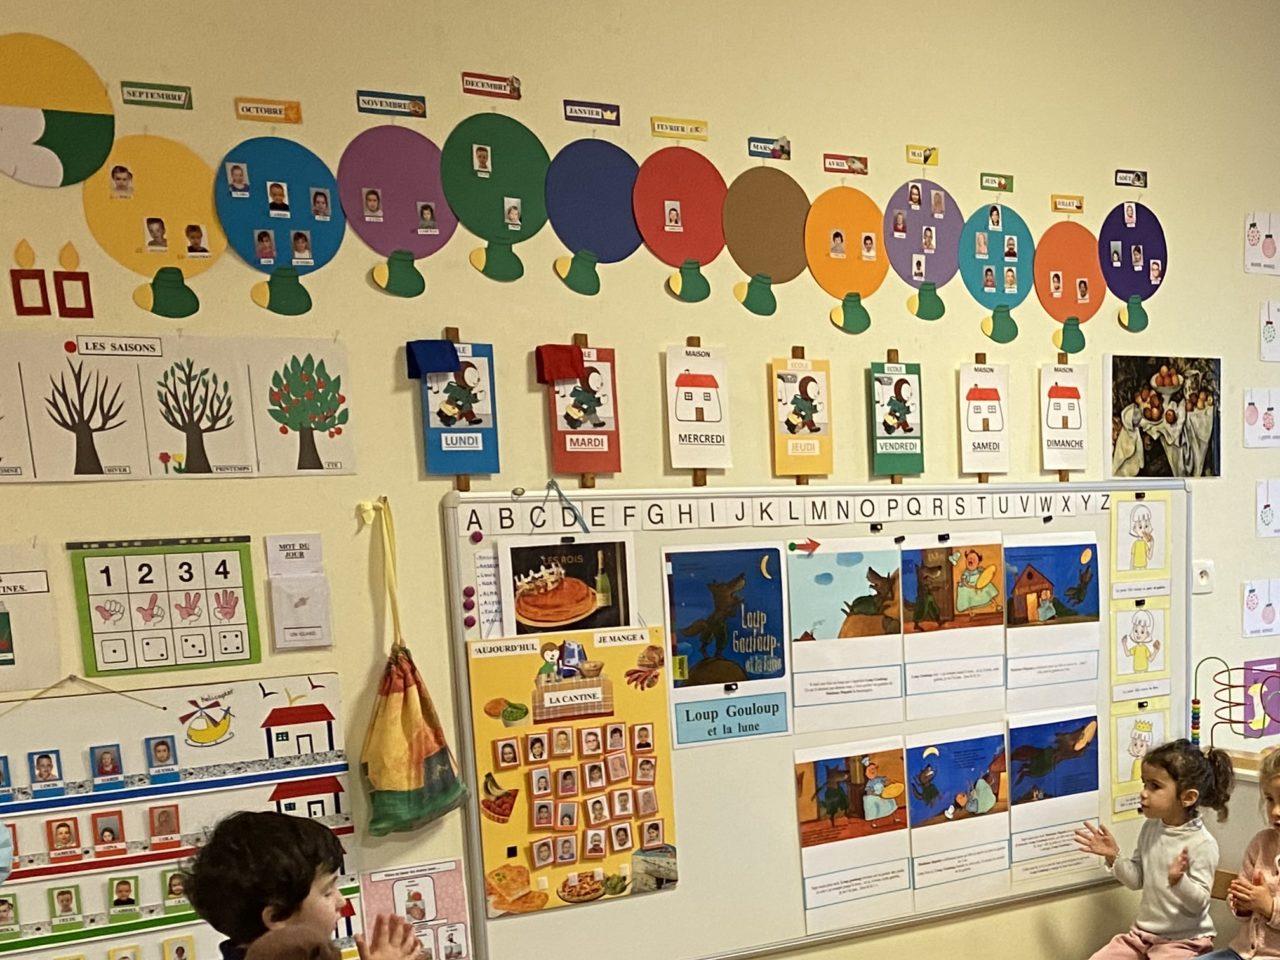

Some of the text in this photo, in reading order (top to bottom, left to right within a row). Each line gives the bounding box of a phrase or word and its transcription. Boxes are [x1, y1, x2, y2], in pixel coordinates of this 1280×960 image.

[465, 79, 508, 91] DECEMBRE
[126, 90, 183, 102] SEPTEMBRE
[361, 98, 408, 110] NOVEMBRE
[241, 106, 283, 116] OCTOBRE
[569, 108, 600, 117] JANVIER
[752, 143, 771, 151] MARS
[828, 160, 845, 168] AVRIL
[85, 341, 157, 353] LES SAISONS
[685, 350, 711, 358] MAISON
[886, 365, 902, 373] ECOLE
[445, 435, 479, 447] LUNDI
[569, 436, 604, 447] MARDI
[678, 433, 726, 444] MERCREDI
[1047, 439, 1084, 448] DIMANCHE
[792, 442, 815, 452] JEUDI
[879, 442, 917, 451] VENDREDI
[972, 441, 1000, 450] SAMEDI
[466, 509, 483, 531] A
[500, 508, 514, 529] B
[530, 507, 546, 527] C
[562, 507, 578, 527] D
[591, 507, 605, 526] E
[624, 506, 636, 526] F
[648, 504, 664, 524] G
[679, 504, 692, 523] H
[735, 502, 745, 521] J
[760, 502, 773, 521] K
[789, 501, 799, 520] L
[812, 501, 827, 519] M
[838, 501, 849, 518] N
[860, 499, 875, 517] O
[888, 499, 898, 517] P
[907, 498, 921, 516] Q
[933, 498, 943, 516] R
[955, 497, 965, 515] S
[977, 497, 986, 514] T
[999, 497, 1008, 513] U
[1020, 496, 1029, 513] V
[1040, 496, 1052, 512] W
[1062, 495, 1071, 512] X
[1081, 494, 1091, 510] Y
[1101, 494, 1110, 510] Z
[279, 543, 296, 551] MOT
[285, 551, 304, 559] JOUR
[560, 555, 583, 564] ROIS
[100, 560, 230, 586] 1 2 3 4
[741, 603, 767, 634] Loup
[598, 636, 607, 644] JE
[609, 634, 637, 643] MANGE
[733, 629, 777, 657] Gouloup
[549, 696, 561, 705] LA
[685, 702, 779, 723] Loup Gouloup
[707, 721, 760, 736] et la lune
